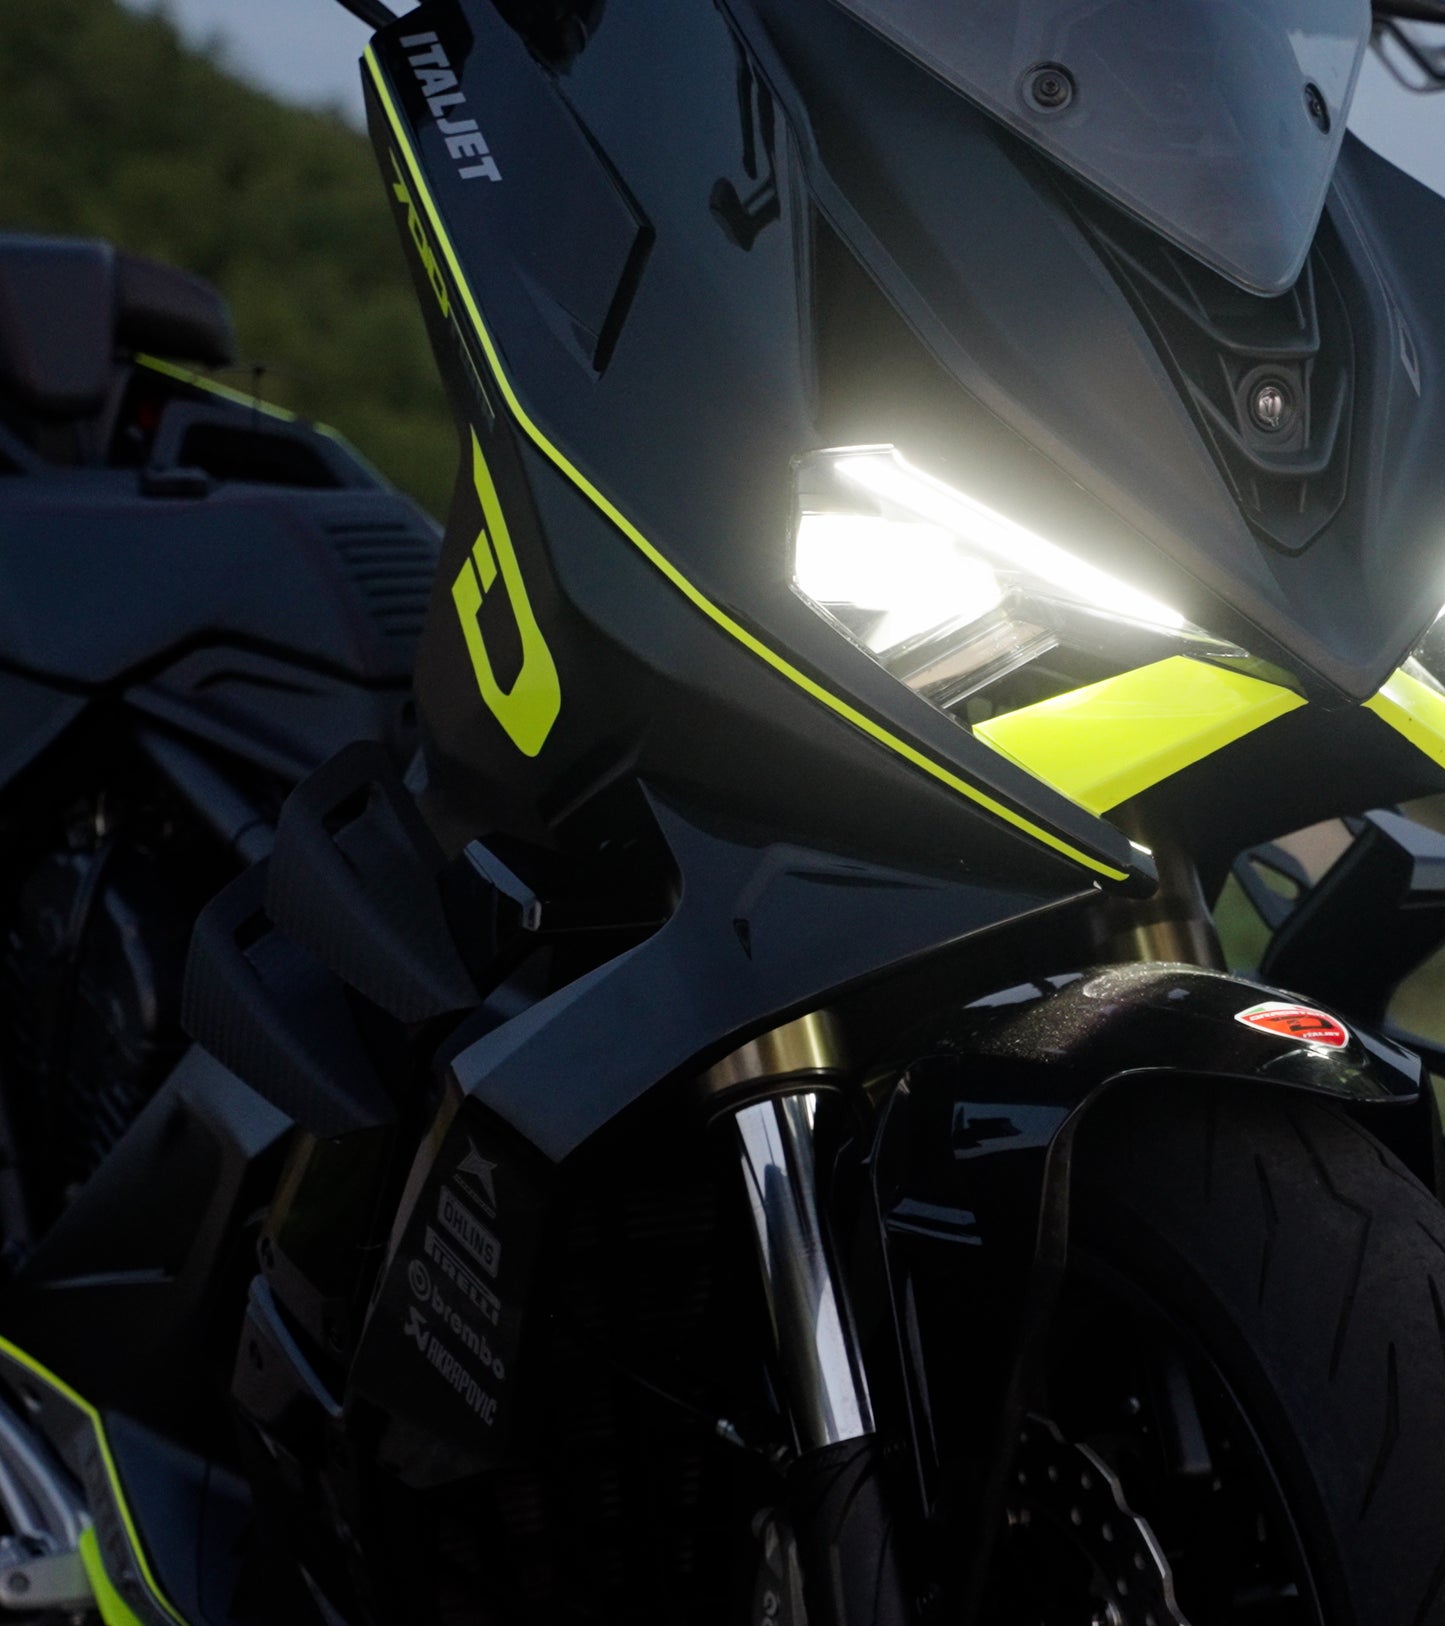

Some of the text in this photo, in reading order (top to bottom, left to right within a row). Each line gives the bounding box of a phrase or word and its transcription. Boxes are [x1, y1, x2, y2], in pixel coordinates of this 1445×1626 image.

[399, 30, 503, 182] ITALJET
[424, 1225, 502, 1327] PIRELLI
[431, 1285, 505, 1380] brembo
